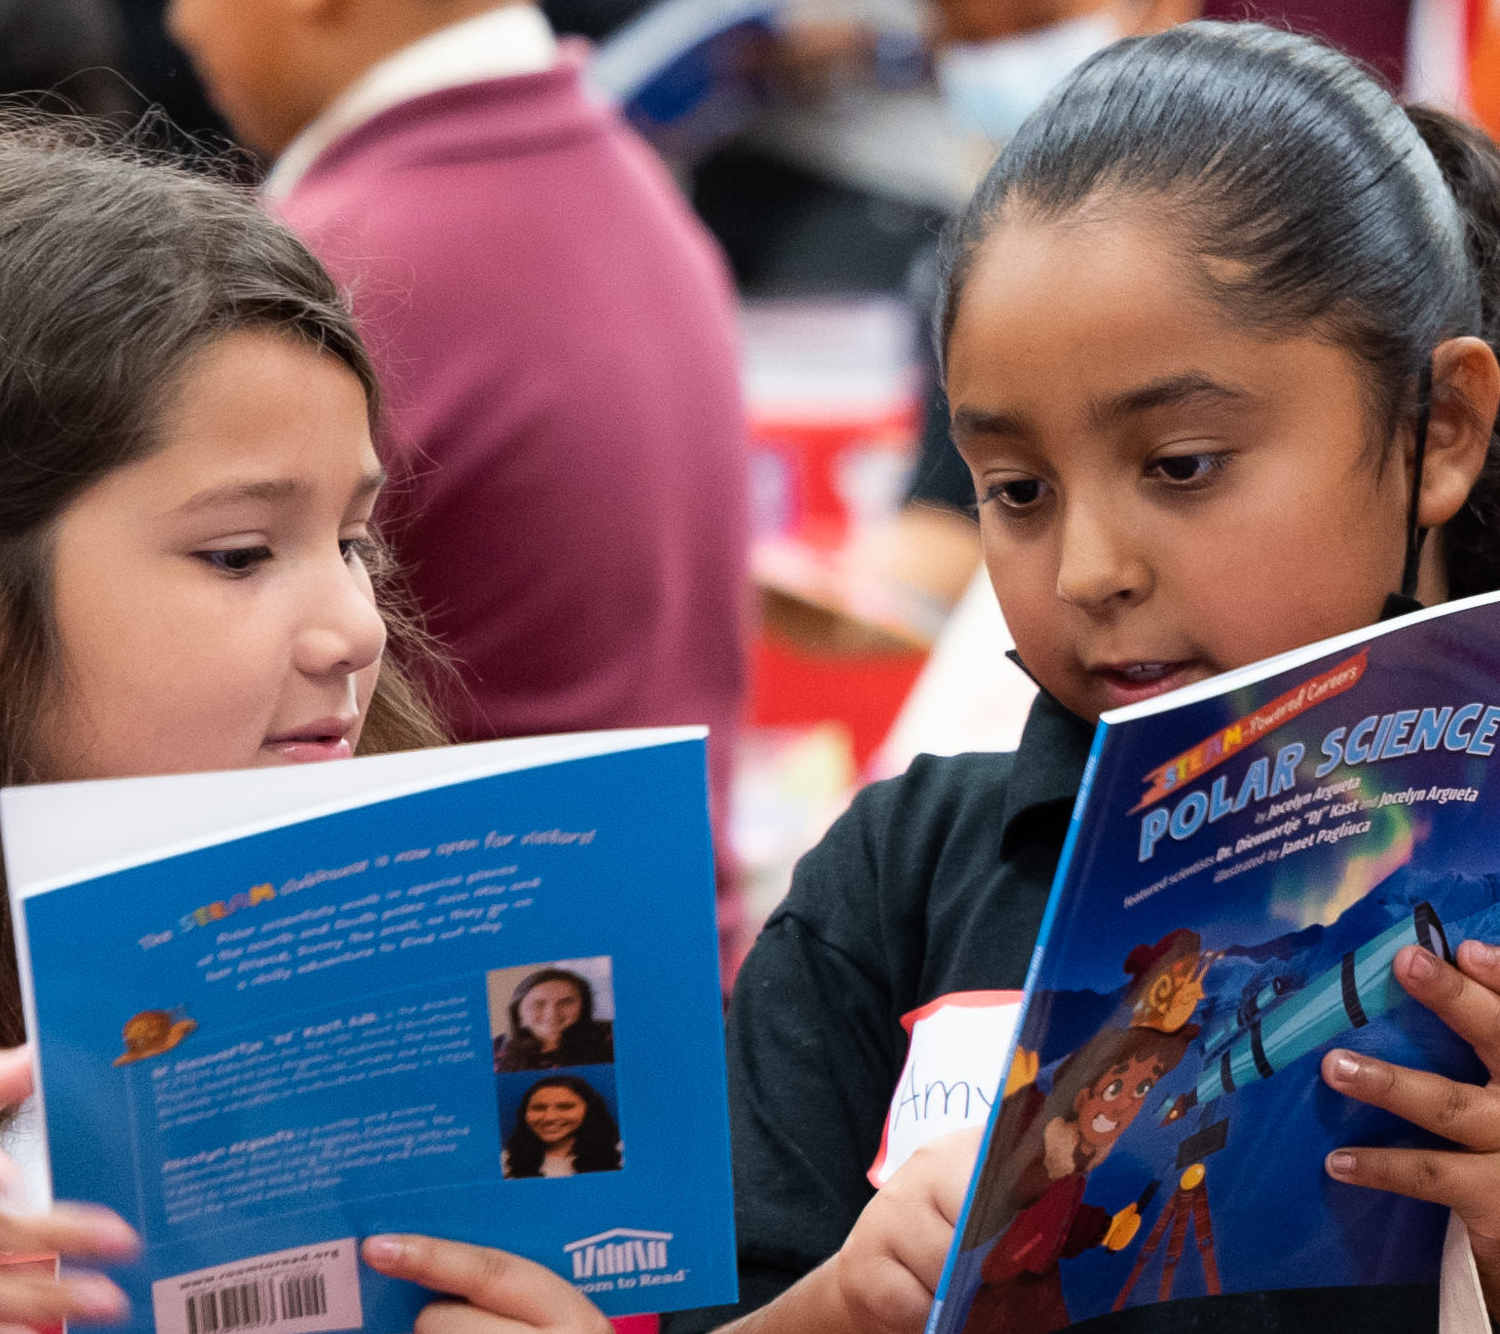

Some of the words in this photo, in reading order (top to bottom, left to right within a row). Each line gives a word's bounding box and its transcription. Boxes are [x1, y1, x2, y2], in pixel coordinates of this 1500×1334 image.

[1138, 742, 1305, 863] POLAR
[1267, 790, 1312, 820] Jocelyn
[1313, 777, 1361, 803] Argueta
[1216, 845, 1233, 863] Dr.
[1330, 799, 1359, 819] Kast
[1379, 786, 1427, 808] Jocelyn
[1428, 786, 1479, 805] Argueta
[1280, 835, 1314, 858] Janet
[1315, 820, 1371, 845] Pagliuca
[574, 1281, 614, 1294] oom
[617, 1278, 636, 1290] to
[640, 1269, 685, 1288] Read
